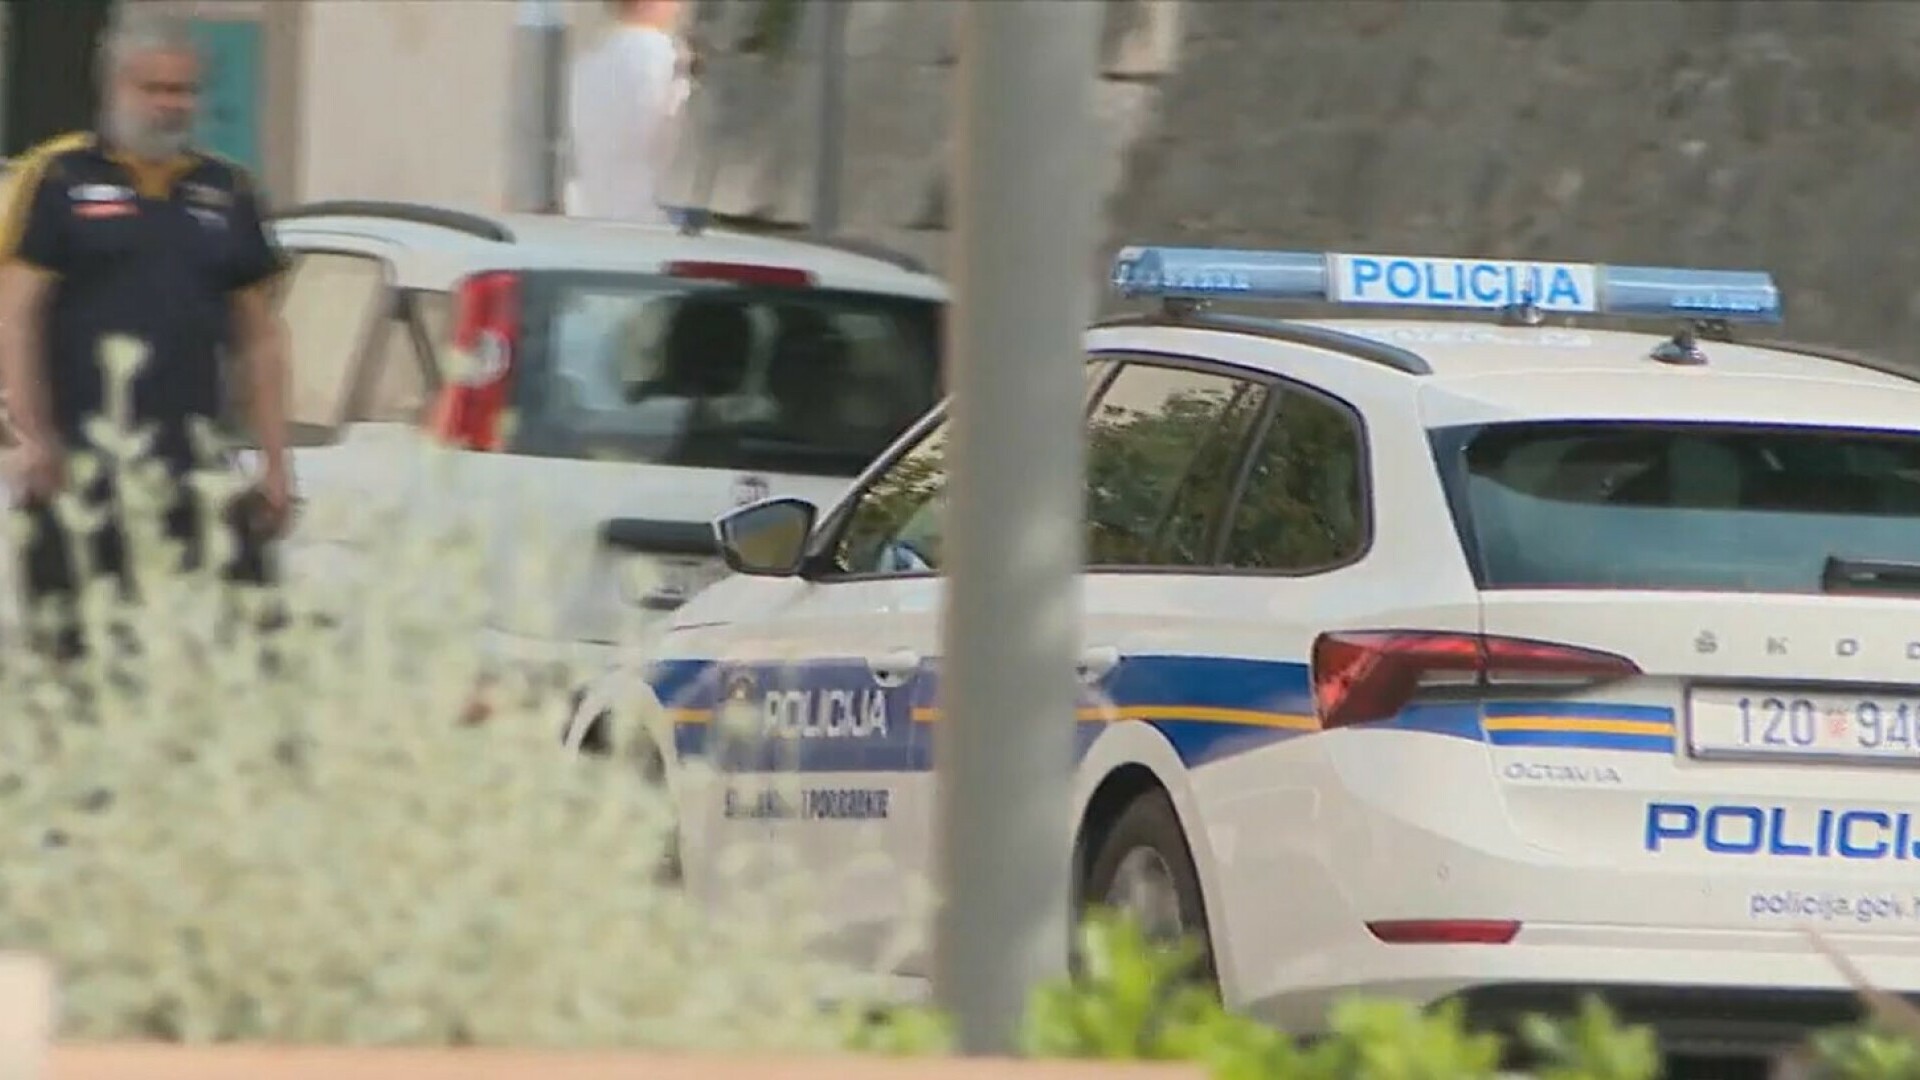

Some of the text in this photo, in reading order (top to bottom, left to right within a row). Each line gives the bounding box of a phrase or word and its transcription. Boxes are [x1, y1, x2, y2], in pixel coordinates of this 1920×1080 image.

[1351, 258, 1582, 306] POLICIJA
[763, 689, 888, 738] POLICIJA
[1737, 697, 1816, 746] 120
[1504, 762, 1622, 784] OCTAVIA
